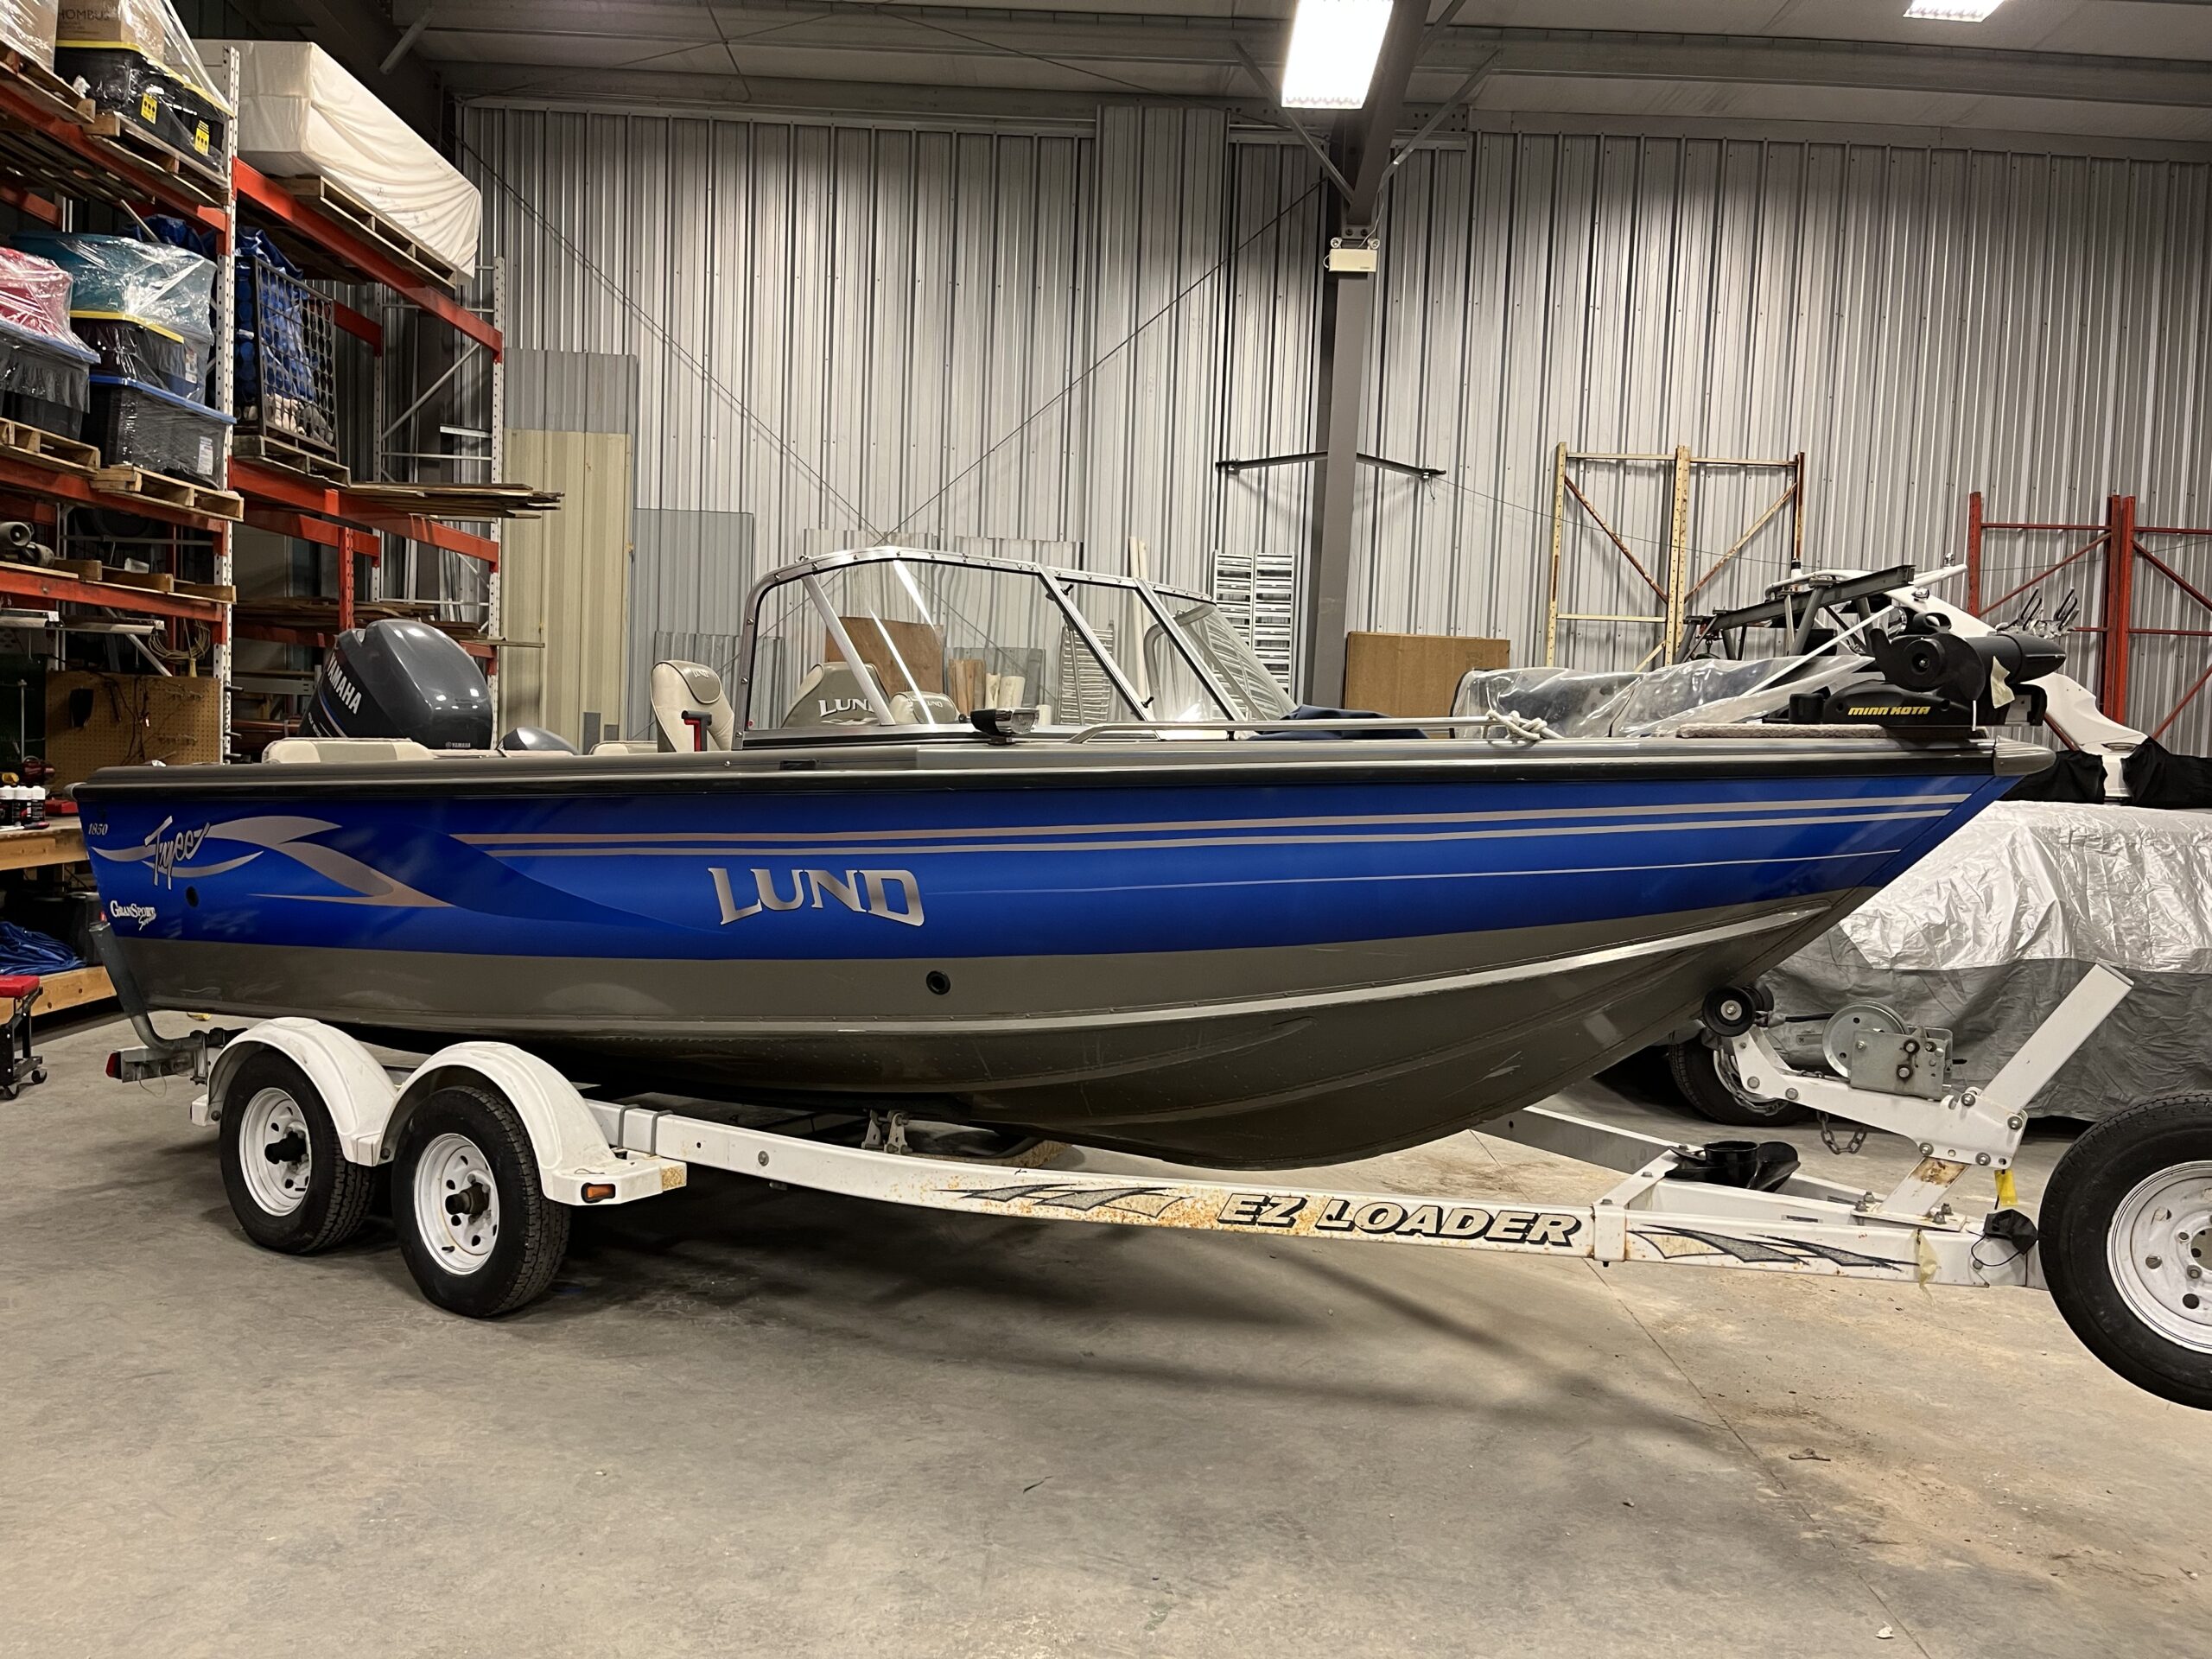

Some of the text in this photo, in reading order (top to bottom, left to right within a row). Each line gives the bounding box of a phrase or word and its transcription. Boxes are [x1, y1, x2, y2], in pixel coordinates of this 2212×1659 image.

[1847, 705, 1932, 716] MINN KOTA
[88, 823, 109, 836] 1850
[144, 815, 211, 891] Tyee
[708, 867, 925, 927] LUND
[1217, 1192, 1582, 1248] EZ LOADER
